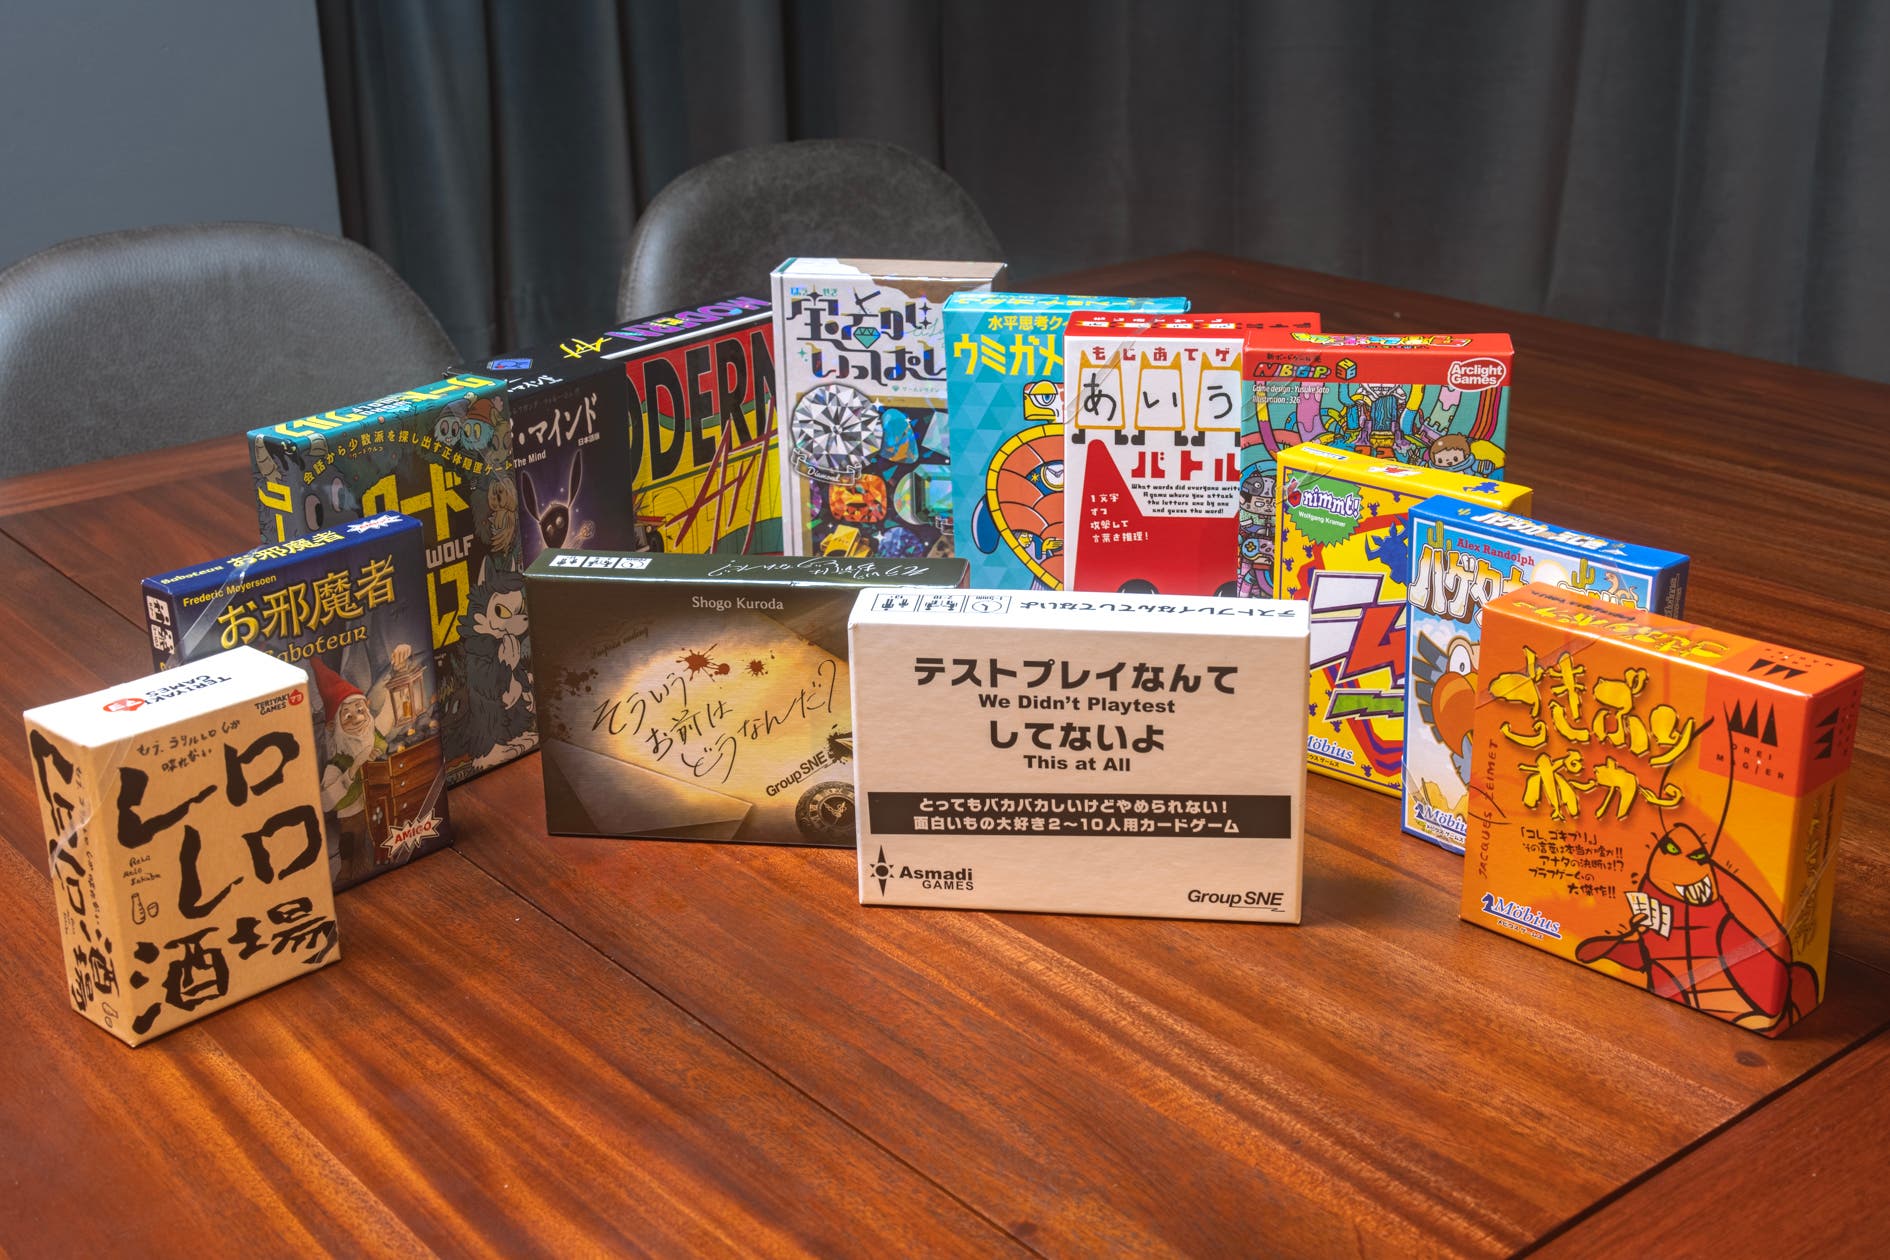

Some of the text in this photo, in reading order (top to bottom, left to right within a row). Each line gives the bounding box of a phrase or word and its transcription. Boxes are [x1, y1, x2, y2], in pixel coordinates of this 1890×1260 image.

[1451, 364, 1503, 379] Arclight
[1451, 374, 1498, 386] Games
[1083, 373, 1232, 421] あ い う
[510, 392, 598, 448] ・マインド
[513, 449, 547, 469] The Mind
[1131, 450, 1240, 481] バトル
[807, 466, 841, 482] Diamond
[1301, 487, 1361, 518] nimmt!
[1298, 511, 1347, 529] Wolfgang Kramer
[226, 530, 345, 568] お邪魔者
[425, 534, 474, 569] WOLF
[1456, 537, 1535, 567] Alex Randolph
[160, 565, 225, 585] Saboteur
[183, 574, 278, 608] Frederic Moyersoen
[217, 554, 396, 650] お邪魔者
[692, 596, 784, 611] Shogo Kuroda
[1020, 600, 1296, 618] テストプレイなんてしてないよ
[144, 676, 233, 705] TERIYAKI
[145, 674, 211, 696] GAMES
[914, 657, 1239, 695] テストプレイなんて
[254, 692, 290, 709] TERIYAKI
[259, 702, 287, 716] GAMES
[593, 672, 689, 736] そういう
[978, 694, 1013, 709] We
[1087, 697, 1176, 714] Playtest
[1489, 646, 1697, 768] ごきぶり
[645, 699, 734, 761] お前は
[989, 720, 1165, 752] してないよ
[1024, 755, 1132, 772] This at All
[1730, 741, 1774, 761] DREI
[1715, 752, 1785, 781] MAGIER
[1478, 739, 1499, 880] JACQUES ZEIMET
[393, 820, 433, 846] AMIGO
[899, 865, 974, 881] Asmadi
[921, 878, 975, 891] GAMES
[1528, 866, 1595, 881] ブラフゲームの
[1494, 898, 1561, 933] Möbius
[129, 897, 337, 1035] 酒場
